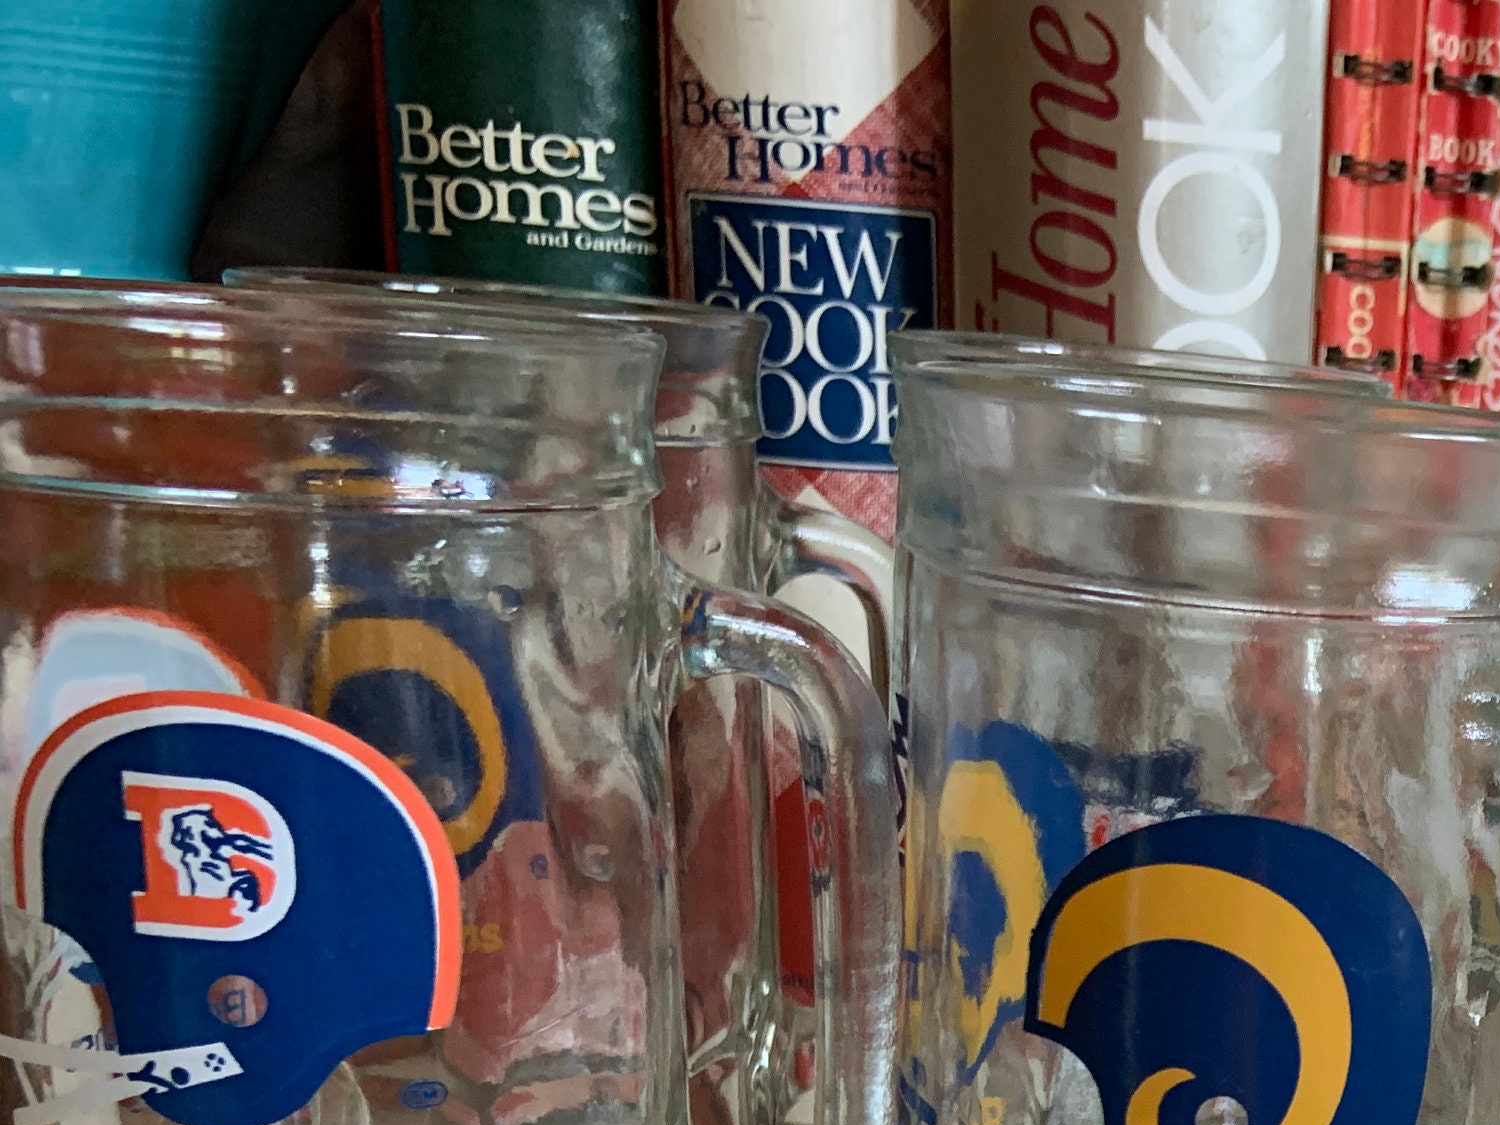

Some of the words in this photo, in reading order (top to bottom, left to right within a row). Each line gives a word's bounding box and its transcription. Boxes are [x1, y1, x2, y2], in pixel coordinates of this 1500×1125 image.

[395, 103, 616, 182] Better
[680, 79, 841, 138] Better
[722, 133, 938, 184] Homes
[974, 3, 1121, 344] Home
[1136, 15, 1288, 361] OK
[400, 172, 658, 236] Homes
[526, 230, 569, 249] and
[713, 215, 904, 303] NEW
[704, 289, 918, 375] OOK
[1346, 284, 1376, 359] COO
